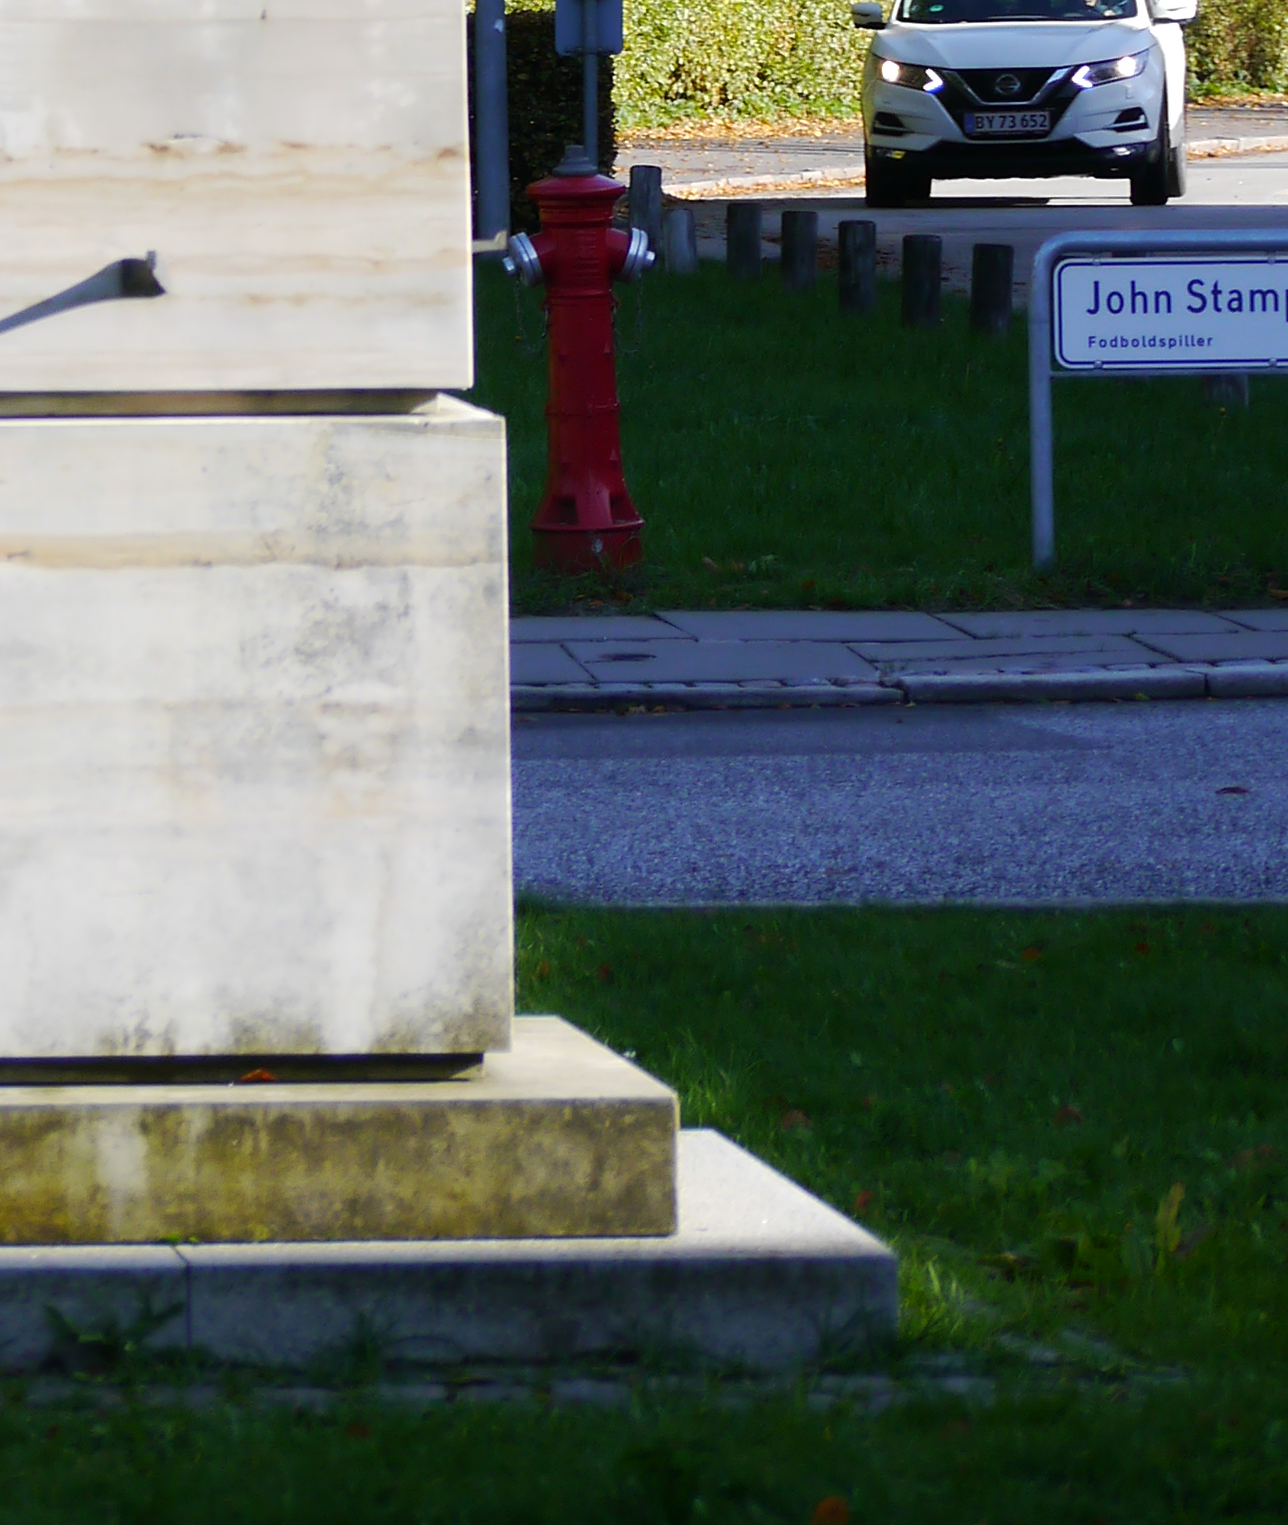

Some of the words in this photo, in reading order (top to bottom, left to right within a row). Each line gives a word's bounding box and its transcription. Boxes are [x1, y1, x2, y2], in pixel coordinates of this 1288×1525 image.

[975, 115, 995, 129] BY
[998, 115, 1017, 129] 73
[1020, 114, 1048, 128] 652
[1085, 280, 1172, 315] John
[1186, 278, 1288, 322] Stam
[1087, 334, 1214, 349] Fodboldspiller
